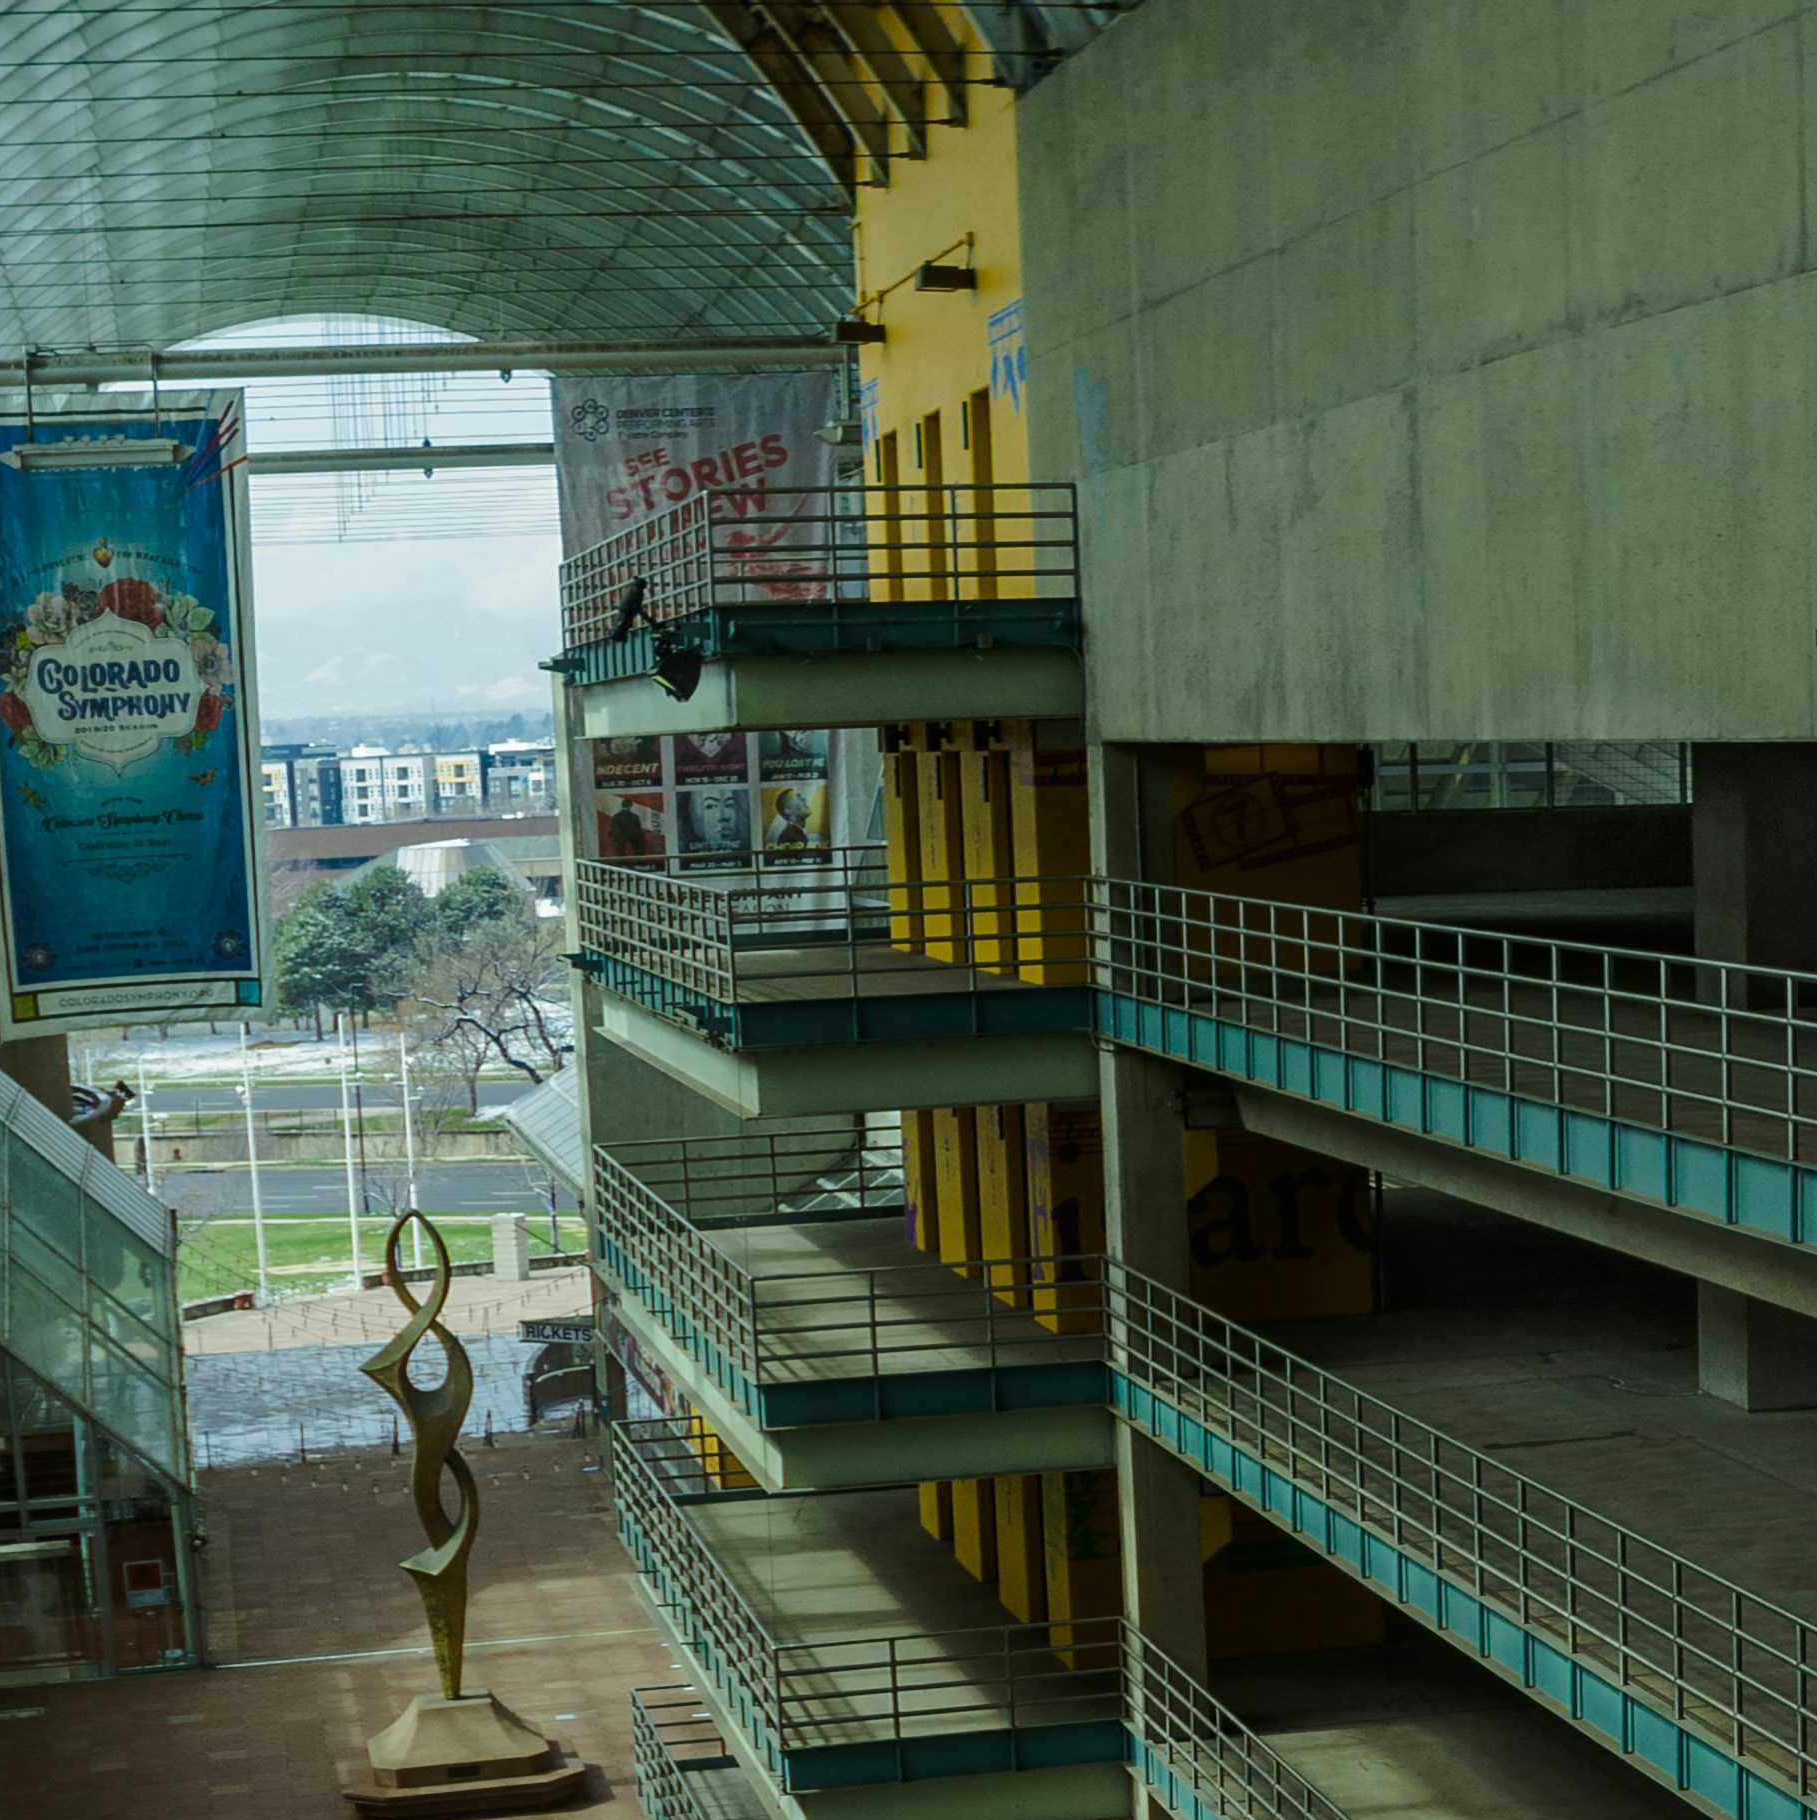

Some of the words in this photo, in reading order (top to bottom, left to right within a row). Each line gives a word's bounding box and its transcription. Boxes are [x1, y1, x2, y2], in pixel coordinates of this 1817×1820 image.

[616, 408, 659, 419] DENVER
[616, 418, 686, 429] PERFORMING
[624, 446, 670, 477] SEE
[607, 433, 788, 520] STORIES
[37, 657, 181, 695] COLORADO
[57, 690, 191, 721] SYMPHONY
[763, 759, 784, 769] YOU
[785, 758, 812, 768] LOST
[97, 810, 160, 830] Symphony
